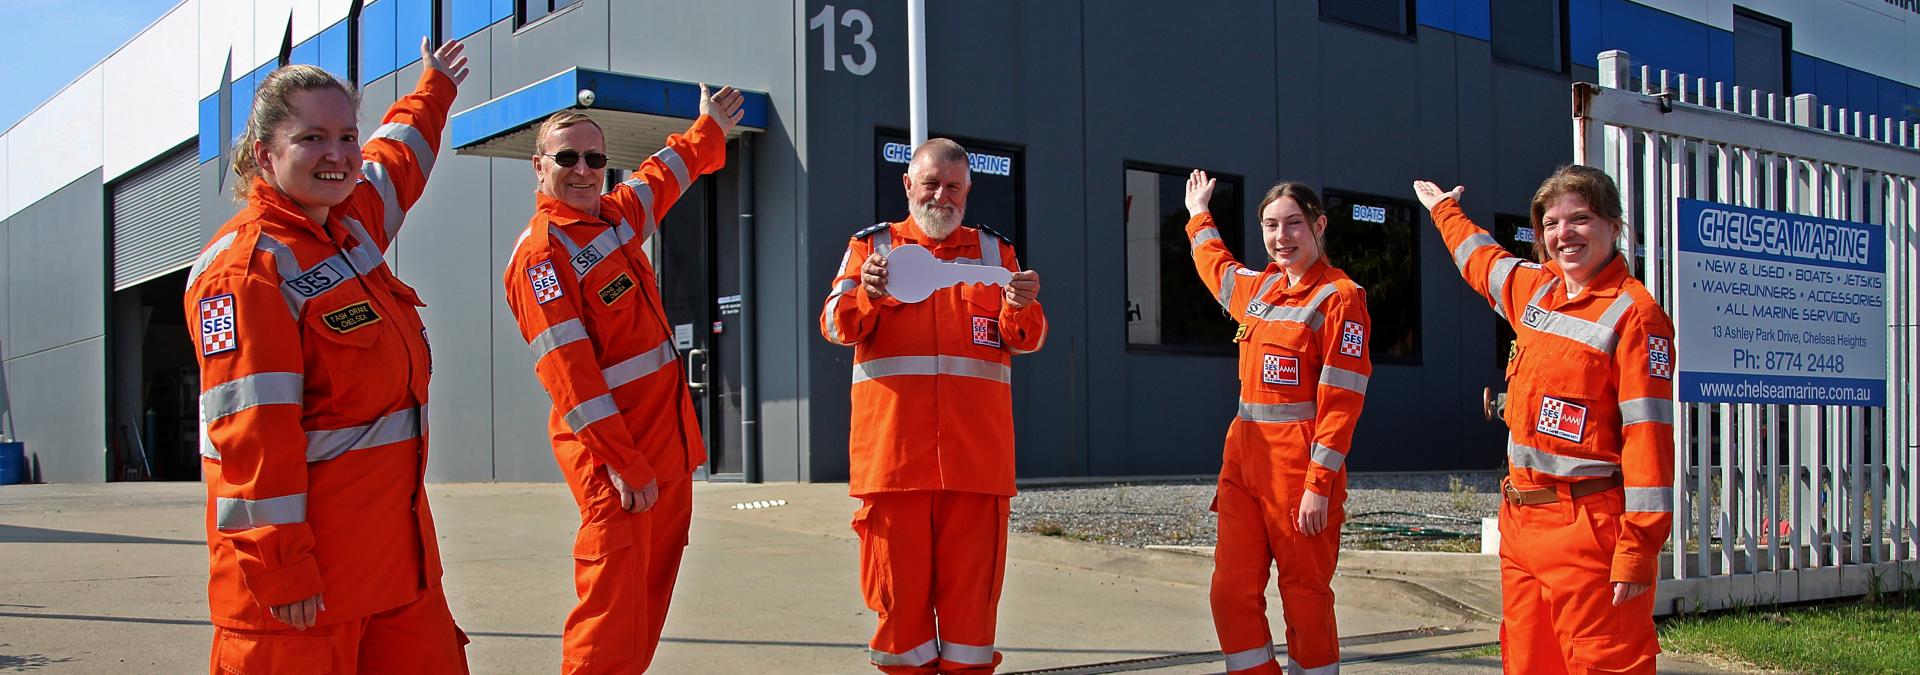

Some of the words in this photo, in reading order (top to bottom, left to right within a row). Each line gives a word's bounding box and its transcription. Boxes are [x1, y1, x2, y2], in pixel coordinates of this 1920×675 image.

[809, 4, 878, 76] 13
[968, 152, 1011, 176] ARINE
[1353, 204, 1385, 223] BOATS
[1515, 227, 1536, 242] JETS
[1699, 209, 1791, 256] CHELSEA
[1792, 221, 1869, 264] MARINE
[577, 250, 597, 269] SES
[295, 270, 331, 294] SES
[534, 275, 557, 291] SES
[1705, 259, 1736, 274] NEW
[1738, 263, 1748, 275] &
[1752, 265, 1785, 279] USED
[1795, 269, 1834, 284] BOATS
[1843, 274, 1882, 288] JETSKIS
[1701, 279, 1797, 300] WAVERUNNERS
[1807, 290, 1883, 307] ACCESSORIES
[330, 312, 348, 323] TASH
[341, 313, 368, 328] CHELSEA
[1724, 302, 1749, 316] ALL
[1752, 305, 1799, 320] MARINE
[1802, 308, 1861, 324] SERVICING
[203, 316, 232, 334] SES
[974, 325, 986, 333] SES
[1344, 332, 1362, 345] SES
[1712, 325, 1722, 338] 13
[1724, 326, 1754, 343] Ashley
[1756, 328, 1776, 341] Park
[1777, 329, 1801, 344] Drive,
[1802, 331, 1836, 345] Chelsea
[1837, 334, 1867, 349] Heights
[1650, 350, 1669, 364] SES
[1733, 349, 1760, 370] Ph:
[1765, 351, 1802, 371] 8774
[1807, 353, 1845, 373] 2448
[1700, 380, 1871, 401] www.chelseamarine.com.au
[1542, 408, 1559, 419] SES
[1560, 414, 1581, 426] AAMI
